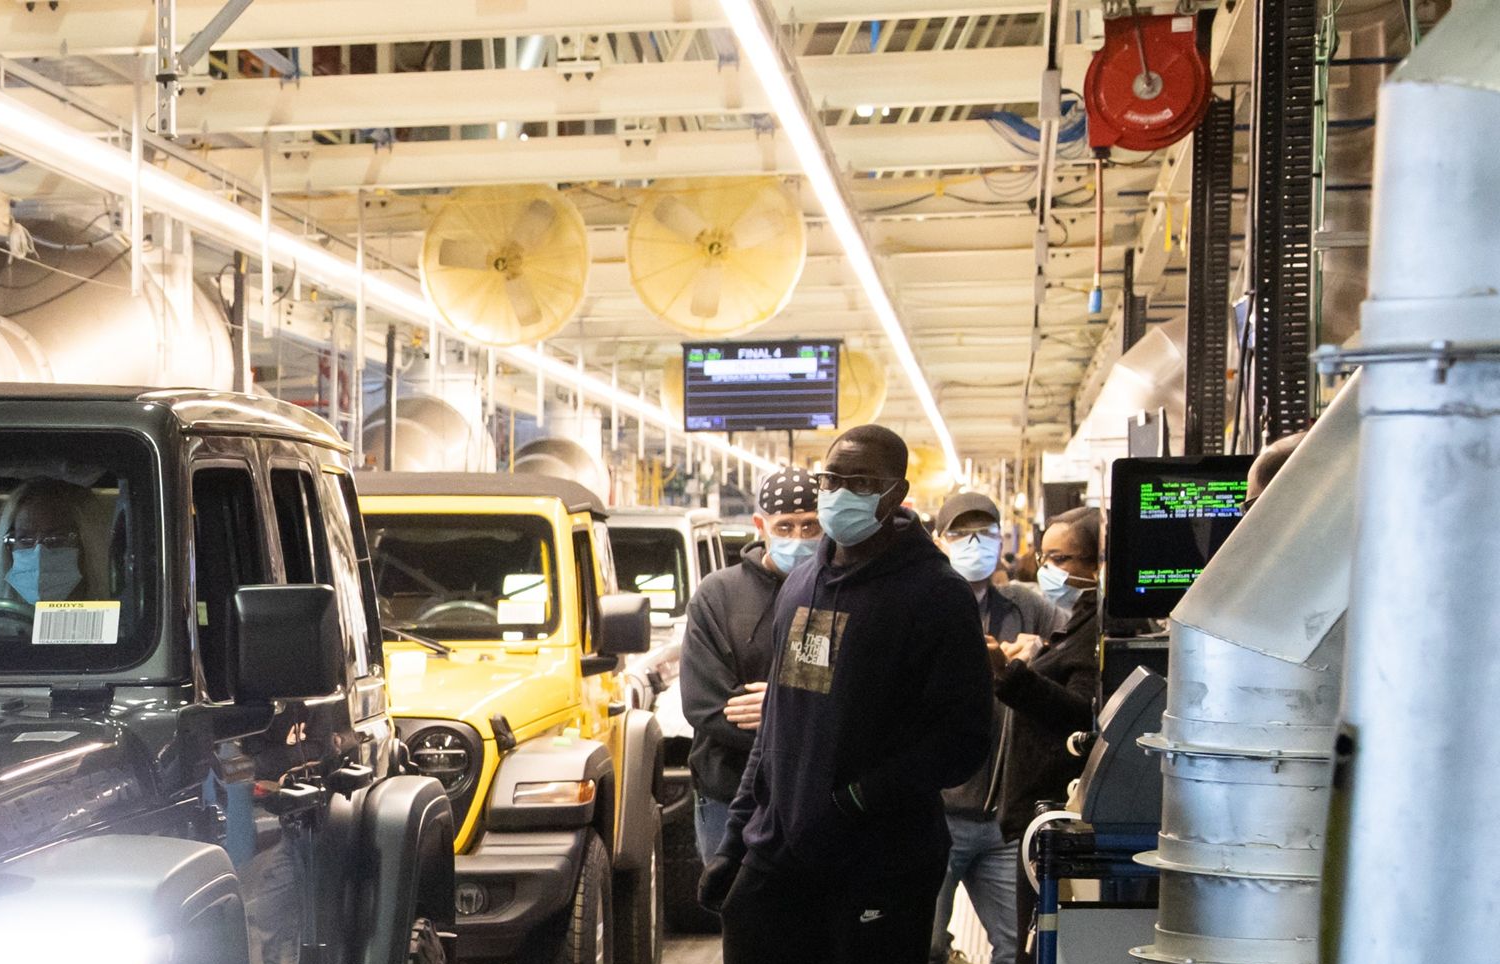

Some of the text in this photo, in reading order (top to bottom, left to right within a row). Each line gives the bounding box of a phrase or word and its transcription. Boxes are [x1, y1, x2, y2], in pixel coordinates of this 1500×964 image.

[737, 347, 782, 359] FINAL 4
[805, 633, 822, 646] THE
[794, 651, 818, 664] FACE
